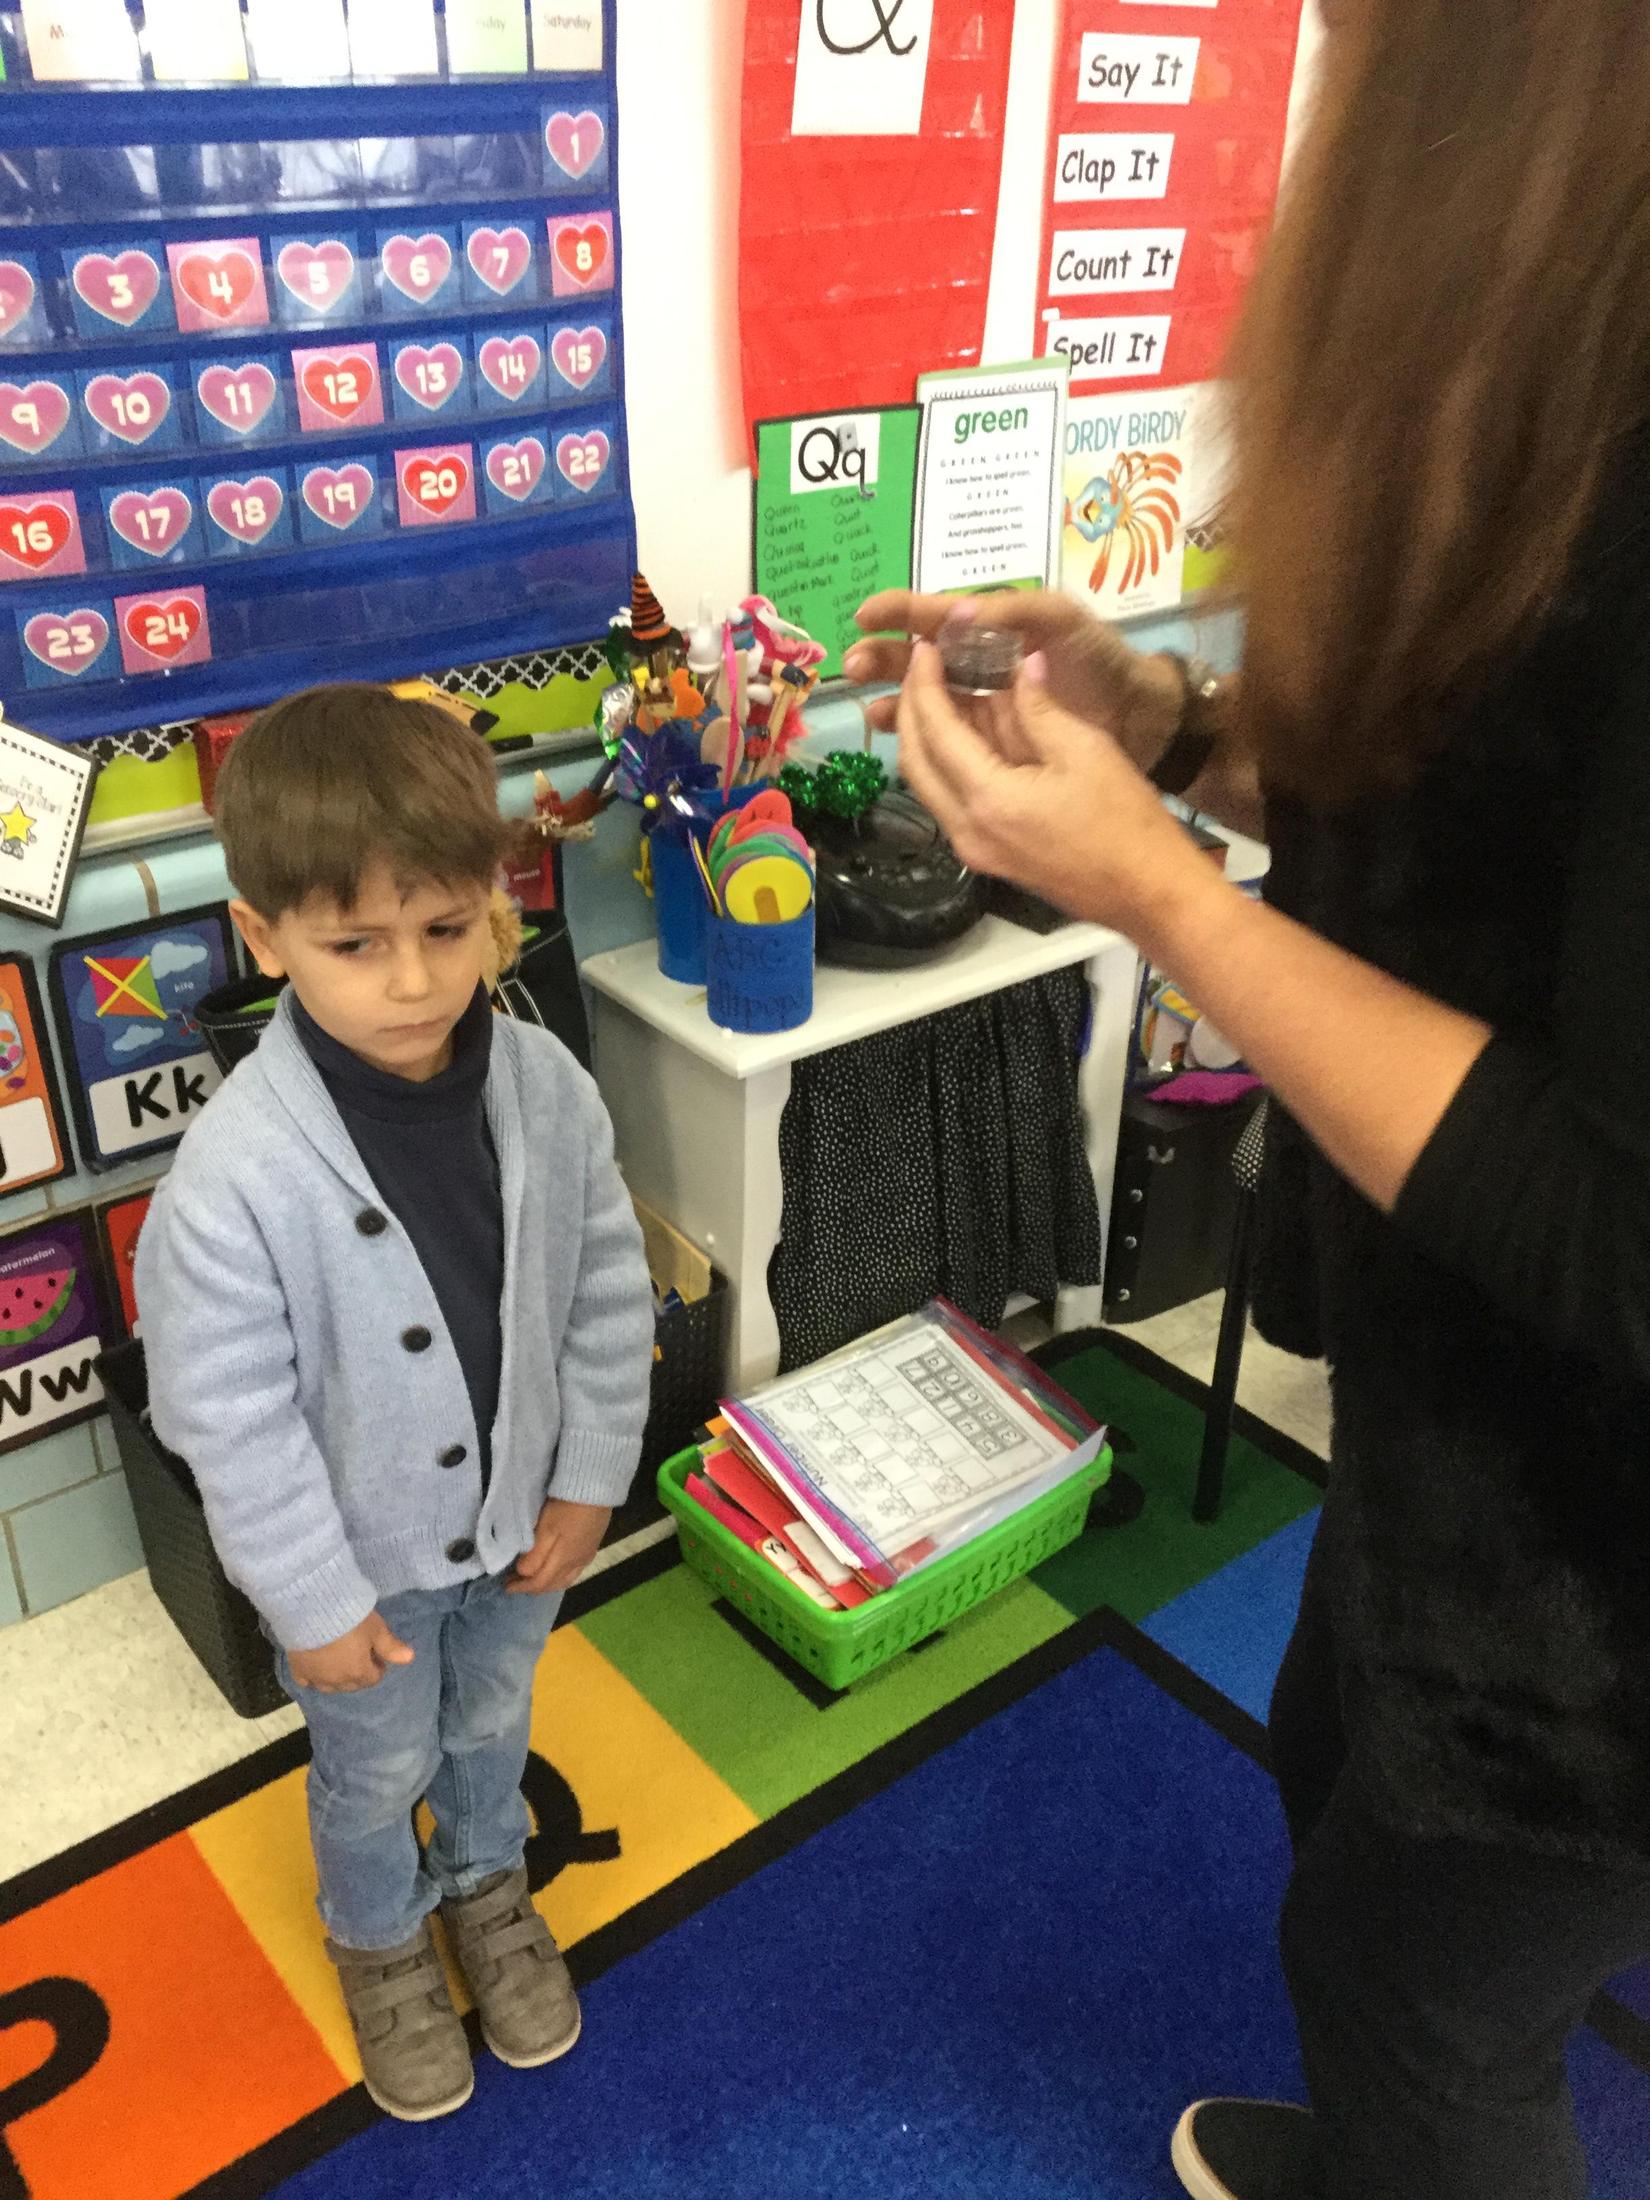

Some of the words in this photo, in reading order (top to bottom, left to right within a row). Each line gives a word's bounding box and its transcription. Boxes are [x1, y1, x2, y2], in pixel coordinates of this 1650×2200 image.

[1088, 54, 1141, 98] Say
[1151, 54, 1183, 86] It
[570, 133, 580, 162] 1
[1062, 150, 1116, 193] Clap
[1128, 149, 1160, 182] It
[109, 275, 133, 308] 3
[208, 270, 233, 304] 4
[308, 262, 329, 295] 5
[410, 256, 430, 286] 6
[492, 248, 509, 277] 7
[577, 242, 592, 270] 8
[1057, 249, 1131, 282] Count
[1143, 247, 1174, 277] It
[1053, 333, 1116, 375] Spell
[1127, 332, 1157, 362] It
[12, 403, 39, 433] 9
[112, 392, 150, 424] 10
[225, 384, 253, 412] 11
[324, 373, 358, 404] 12
[418, 363, 446, 392] 13
[499, 356, 526, 383] 14
[568, 345, 591, 372] 15
[954, 407, 1028, 444] green
[1066, 415, 1122, 455] ORDY
[798, 427, 875, 498] Qq
[12, 522, 52, 552] 16
[136, 508, 170, 539] 17
[232, 496, 266, 528] 18
[324, 483, 355, 513] 19
[420, 470, 456, 499] 20
[504, 457, 530, 486] 21
[570, 446, 600, 476] 22
[48, 625, 94, 656] 23
[146, 614, 188, 643] 24
[174, 980, 194, 993] kite
[124, 1066, 208, 1128] Kk
[0, 1247, 56, 1275] atermelon
